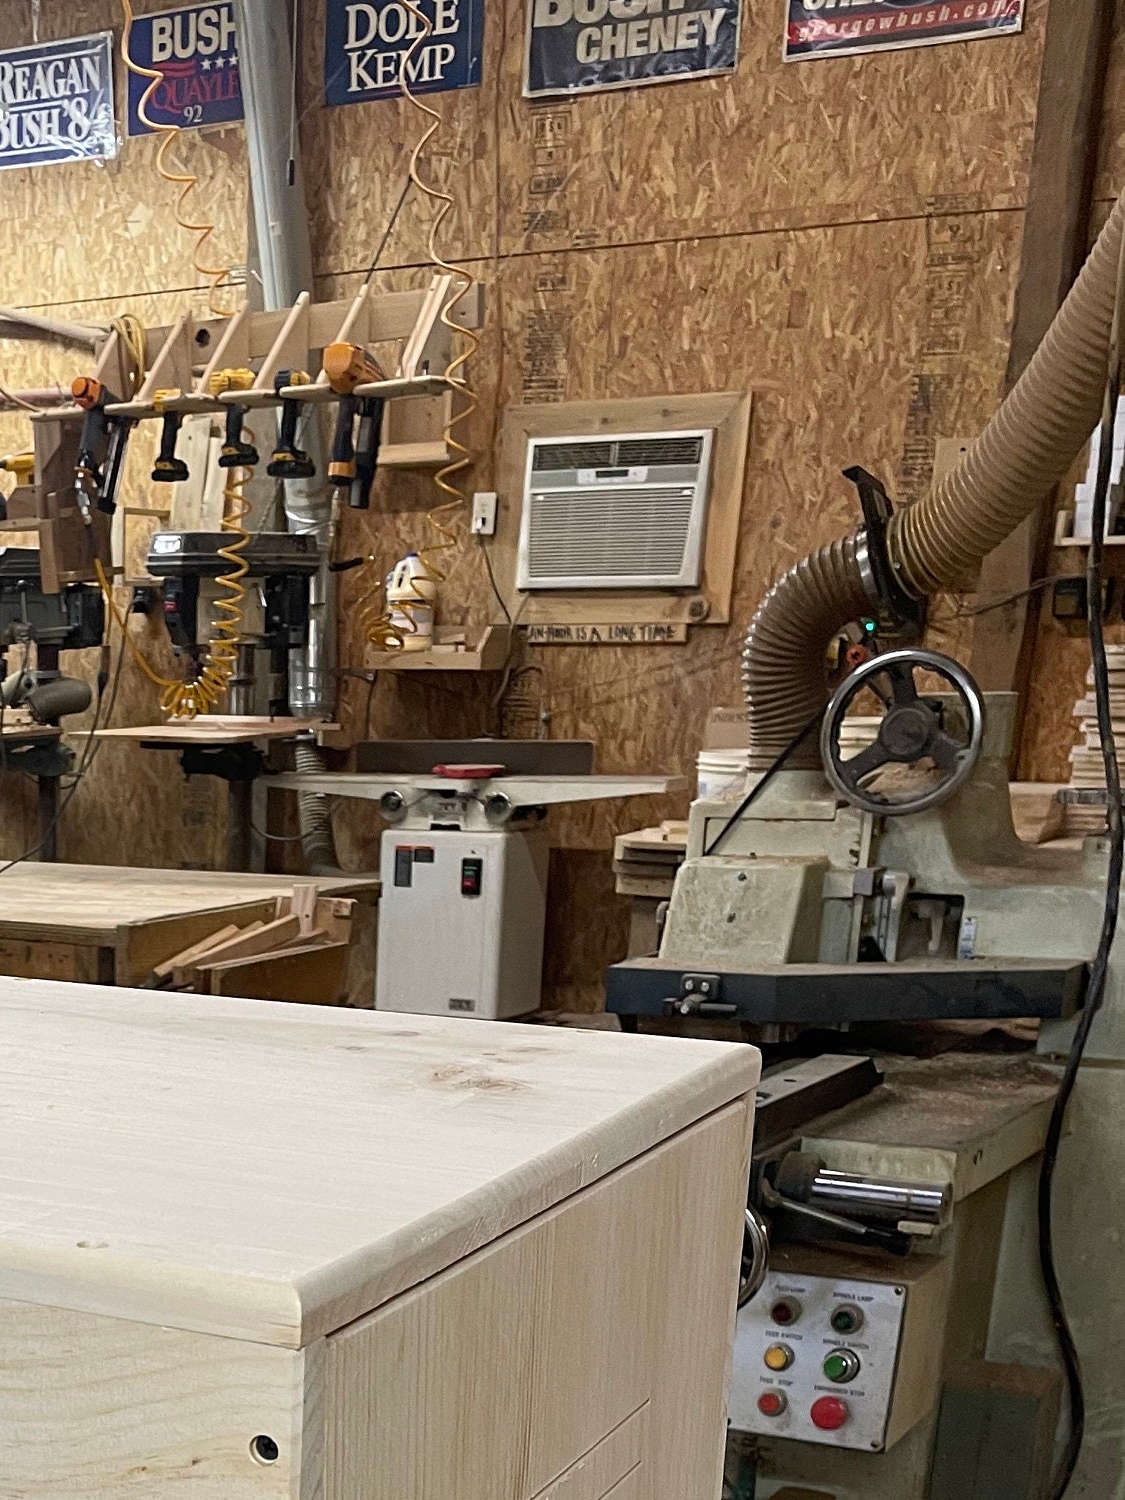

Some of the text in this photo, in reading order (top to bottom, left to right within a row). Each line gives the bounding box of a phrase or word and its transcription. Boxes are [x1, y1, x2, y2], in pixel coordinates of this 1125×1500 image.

[152, 7, 238, 62] BUSH
[343, 0, 460, 49] DOLE
[577, 8, 726, 64] CHENEY
[151, 70, 241, 115] QUAYLE
[347, 44, 456, 92] KEMP
